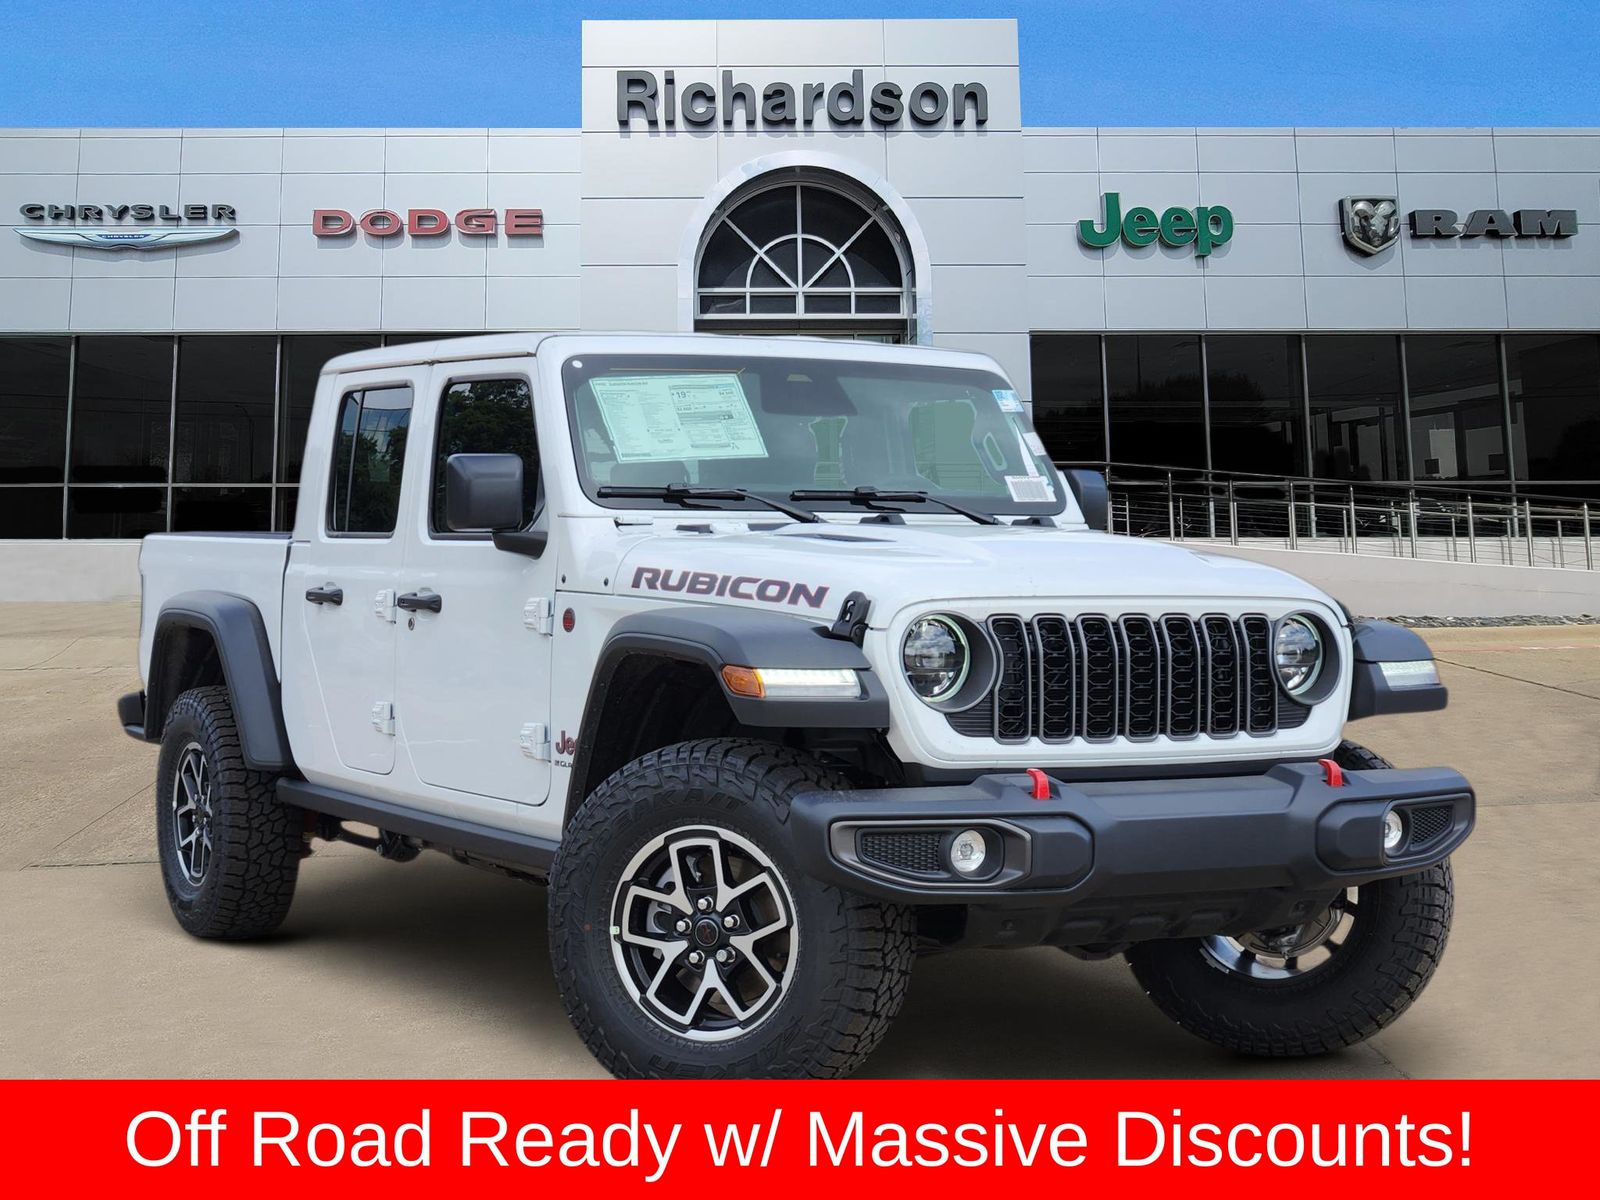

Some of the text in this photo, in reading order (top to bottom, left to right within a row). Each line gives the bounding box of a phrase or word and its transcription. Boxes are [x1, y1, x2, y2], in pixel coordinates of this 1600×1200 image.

[616, 69, 989, 126] Richardson
[19, 203, 237, 220] CHRYSLER
[312, 208, 544, 237] DODGE
[1077, 192, 1234, 258] Jeep
[1409, 209, 1578, 239] RAM
[631, 566, 829, 609] RUBICON
[555, 730, 576, 756] Je
